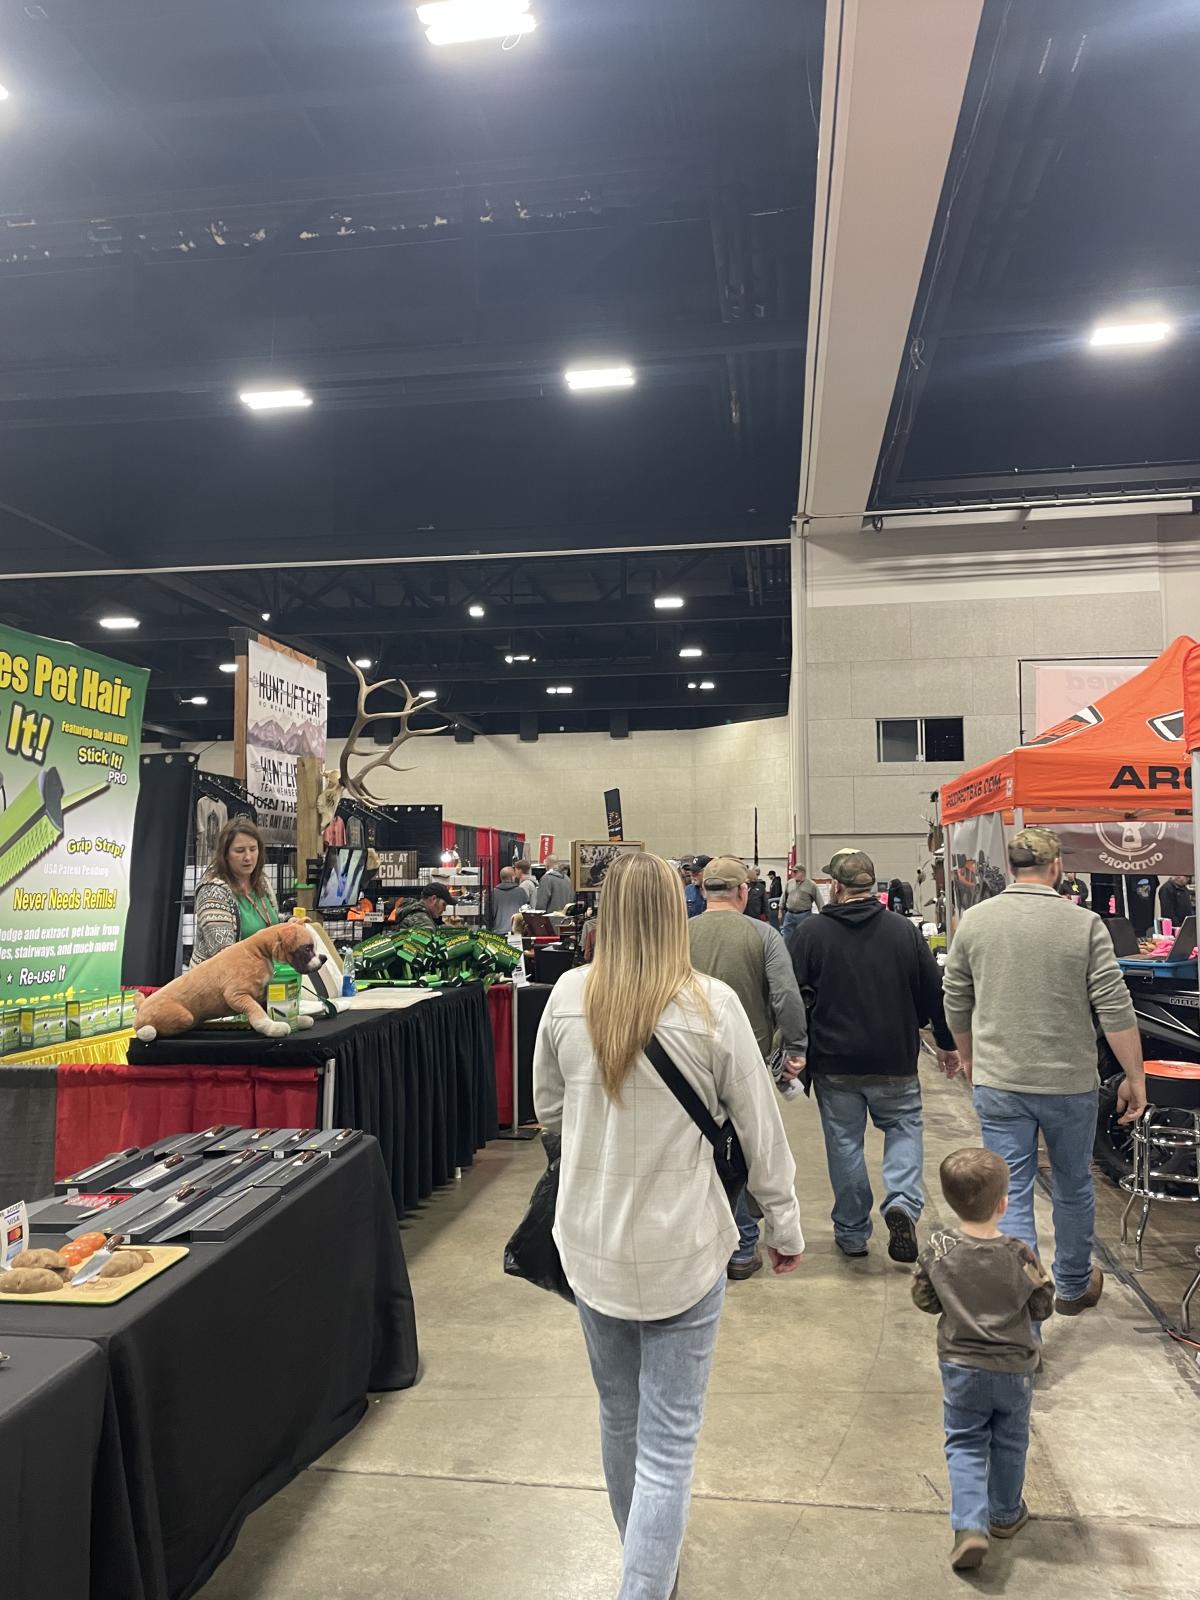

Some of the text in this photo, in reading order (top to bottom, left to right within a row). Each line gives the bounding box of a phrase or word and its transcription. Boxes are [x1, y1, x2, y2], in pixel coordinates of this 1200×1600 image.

[33, 654, 78, 705] Pet
[80, 667, 132, 718] Hair
[258, 671, 321, 718] HUNT LIFT EAT
[6, 702, 54, 766] It!
[62, 721, 93, 739] Featuring
[78, 746, 124, 772] Stick It!
[108, 770, 128, 785] PRO
[1109, 765, 1192, 790] AR
[67, 837, 125, 858] Grip Strip!
[379, 853, 408, 863] BLE AT
[44, 864, 109, 877] USA Patent Pending
[13, 888, 117, 911] Never Needs Refills!
[24, 927, 40, 940] and
[41, 926, 69, 939] extract
[71, 925, 84, 938] pet
[85, 924, 100, 936] hair
[102, 924, 119, 936] from
[15, 943, 56, 959] stairways,
[57, 942, 72, 955] and
[73, 940, 93, 954] much
[94, 940, 117, 953] more!
[19, 964, 66, 985] Re-use It
[7, 1202, 24, 1214] ACCEPT
[7, 1216, 20, 1225] VISA
